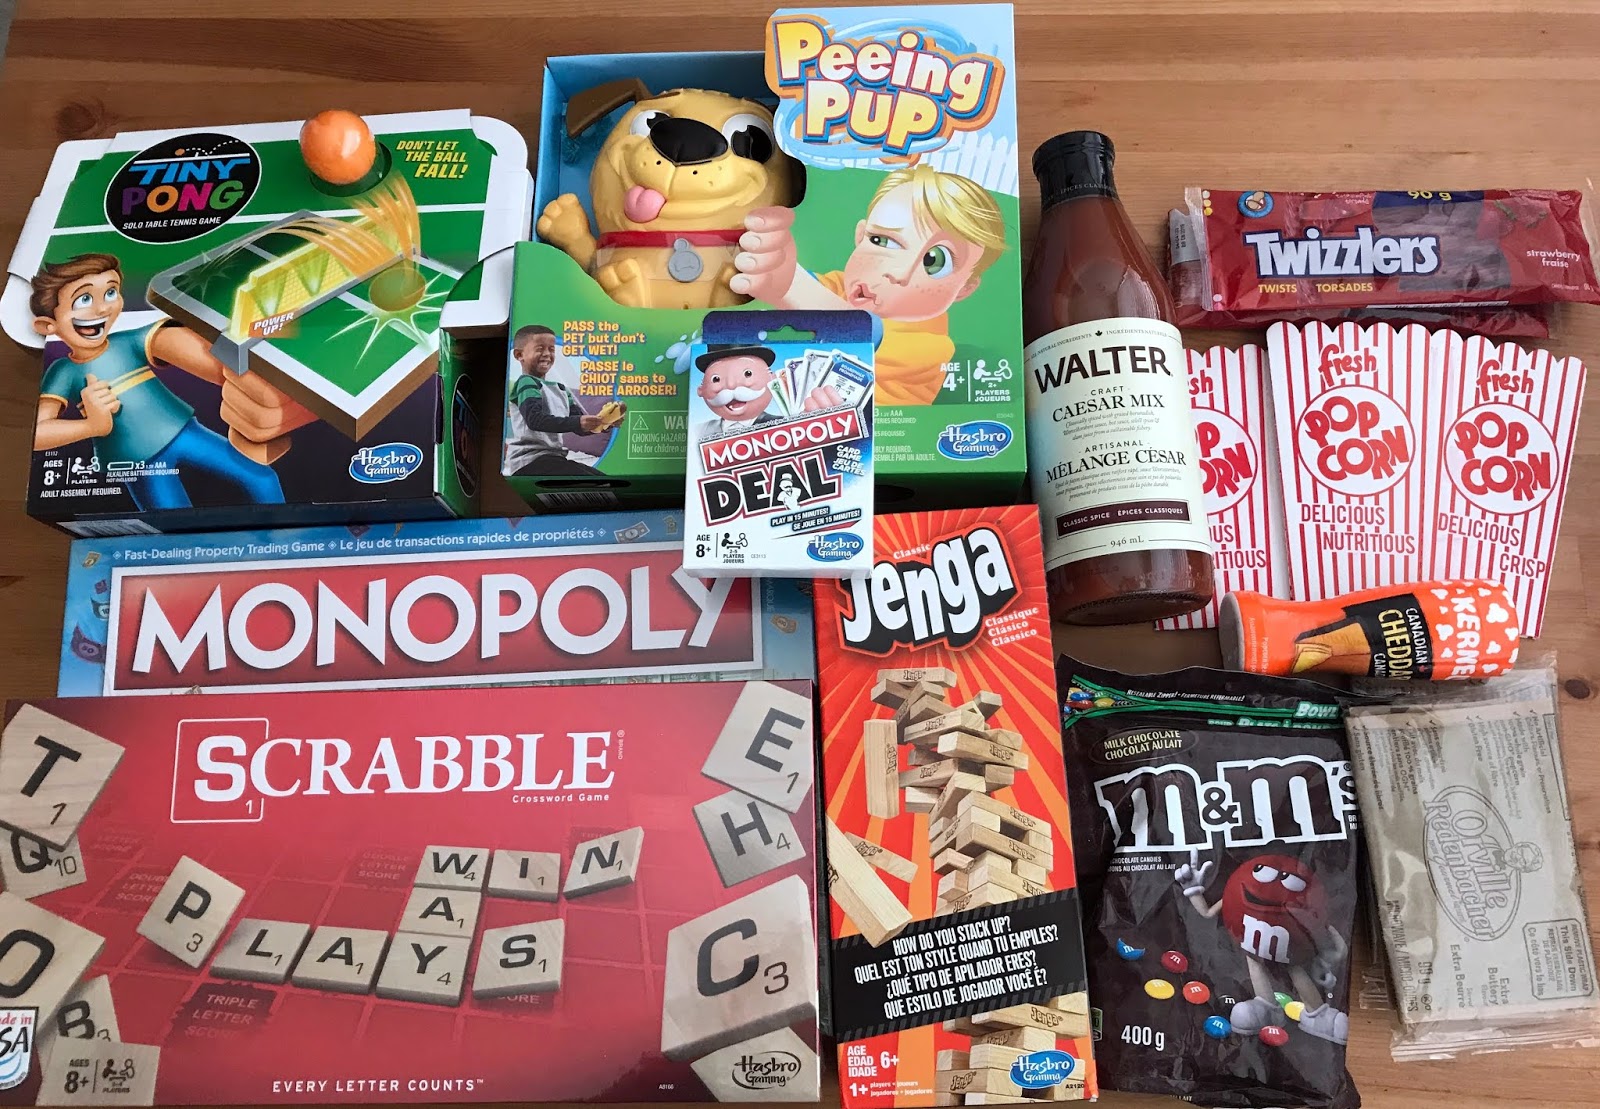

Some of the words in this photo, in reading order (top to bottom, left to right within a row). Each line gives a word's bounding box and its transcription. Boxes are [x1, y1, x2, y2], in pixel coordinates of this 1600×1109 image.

[775, 20, 990, 114] Peeing
[396, 141, 434, 150] DON'T
[436, 141, 459, 150] LET
[405, 151, 429, 162] THE
[433, 151, 467, 163] BALL
[129, 158, 250, 185] TINY
[414, 163, 469, 179] FALL!
[122, 180, 245, 216] PONG
[122, 222, 143, 230] SOLO
[145, 219, 167, 228] TABLE
[170, 217, 197, 227] TENNIS
[199, 216, 221, 225] GAME
[1246, 227, 1439, 276] Twizzlers
[1526, 248, 1580, 262] strawberry
[1542, 258, 1569, 268] fraise
[1258, 284, 1298, 294] TWISTS
[1316, 282, 1374, 293] TORSADES
[253, 312, 294, 331] POWER
[262, 321, 284, 336] UP!
[563, 321, 595, 332] PASS
[598, 321, 620, 332] the
[563, 333, 586, 344] PET
[588, 333, 610, 344] but
[613, 332, 646, 344] don't
[562, 344, 586, 356] GET
[588, 344, 618, 356] WET!
[580, 361, 619, 372] PASSE
[622, 361, 634, 372] le
[940, 362, 961, 372] AGE
[1034, 346, 1171, 394] WALTER
[1318, 344, 1377, 387] fresh
[580, 373, 617, 384] CHIOT
[619, 374, 649, 384] sans
[652, 374, 666, 384] te
[942, 373, 965, 392] 4+
[1476, 359, 1534, 402] fresh
[579, 386, 614, 396] FAIRE
[617, 385, 677, 396] ARROSER!
[1090, 386, 1124, 396] CRAFT
[1052, 395, 1126, 423] CAESAR
[1130, 394, 1166, 408] MIX
[1304, 396, 1380, 448] POP
[709, 414, 852, 468] MONOPOLY
[941, 427, 1006, 445] Hasbro
[1454, 412, 1529, 460] POP
[836, 445, 860, 454] CARD
[952, 441, 997, 455] Gaming
[1084, 440, 1144, 454] ARTISANAL
[1317, 426, 1410, 480] CORN
[43, 460, 63, 468] AGES
[353, 451, 416, 468] Hasbro
[1046, 450, 1130, 484] MÉLANGE
[1135, 447, 1187, 466] CÉSAR
[364, 464, 407, 478] Gaming
[832, 464, 866, 476] CARTES
[1461, 452, 1550, 501] CORN
[40, 490, 60, 498] ADULT
[60, 488, 92, 497] ASSEMBLY
[92, 487, 122, 496] REQUIRED.
[704, 456, 836, 521] DEAL
[772, 516, 786, 526] PLAY
[802, 508, 829, 519] MINUTES!
[801, 520, 816, 529] JOUE
[825, 516, 832, 524] 15
[833, 510, 860, 521] MINUTES!
[1063, 516, 1088, 528] CLASSIC
[1090, 512, 1110, 521] SPICE
[1117, 508, 1142, 517] ÉPICES
[1301, 504, 1385, 526] DELICIOUS
[696, 534, 710, 542] AGE
[1438, 512, 1520, 546] DELICIOUS
[340, 540, 354, 550] Le
[355, 538, 374, 551] jeu
[377, 537, 392, 548] de
[395, 534, 464, 548] transactions
[467, 532, 511, 546] rapides
[514, 531, 530, 542] de
[532, 528, 594, 544] propriétés
[809, 536, 860, 550] Hasbro
[1110, 538, 1127, 548] 946
[1129, 536, 1144, 544] mL
[1323, 532, 1416, 554] NUTRITIOUS
[124, 549, 192, 561] Fast-Dealing
[194, 545, 244, 558] Property
[246, 542, 288, 556] Trading
[292, 542, 325, 552] Game
[818, 548, 852, 558] Gaming
[892, 542, 932, 560] Classic
[1500, 553, 1546, 578] CRISP
[842, 528, 1014, 643] Jenga
[132, 564, 736, 674] MONOPOLY
[984, 606, 1039, 628] Classique
[988, 620, 1029, 638] Clásico
[991, 628, 1038, 647] Clássico
[1406, 607, 1428, 664] CANADIAN
[1104, 738, 1126, 750] MILK
[1127, 730, 1181, 745] CHOCOLATE
[1105, 742, 1151, 760] CHOCOLAT
[1152, 739, 1163, 750] AU
[1164, 739, 1182, 748] LAIT
[194, 730, 616, 802] SCRABBLE
[512, 794, 573, 803] Crossword
[578, 793, 610, 802] Game
[1422, 798, 1496, 940] Redenbacher
[1451, 809, 1510, 910] Orville
[892, 936, 917, 956] HOW
[918, 932, 934, 950] DO
[934, 926, 958, 947] YOU
[958, 920, 991, 943] STACK
[991, 915, 1011, 936] UP?
[854, 964, 882, 984] QUEL
[883, 959, 902, 978] EST
[904, 954, 924, 974] TON
[925, 946, 958, 969] STYLE
[958, 938, 994, 962] QUAND
[995, 935, 1010, 953] TU
[1010, 924, 1059, 951] EMPILES?
[1450, 944, 1463, 972] Extra
[886, 974, 912, 1000] ¿QUÉ
[913, 971, 938, 992] TIPO
[940, 968, 954, 986] DE
[954, 956, 1005, 983] APILADOR
[1005, 949, 1038, 972] ERES?
[883, 998, 906, 1020] QUE
[906, 990, 942, 1015] ESTILO
[944, 987, 958, 1006] DE
[958, 980, 1005, 1004] JOGADOR
[1005, 968, 1034, 994] VOCÊ
[1034, 966, 1048, 988] É?
[1455, 973, 1466, 1008] Beurre
[206, 994, 258, 1009] TRIPLE
[1121, 1025, 1152, 1046] 400
[1155, 1032, 1165, 1052] g
[732, 1055, 797, 1074] Hasbro
[847, 1045, 866, 1056] AGE
[880, 1051, 900, 1069] 6+
[848, 1056, 874, 1066] EDAD
[1012, 1056, 1070, 1074] Hasbro
[848, 1066, 878, 1078] IDADE
[272, 1080, 328, 1094] EVERY
[335, 1080, 400, 1092] LETTER
